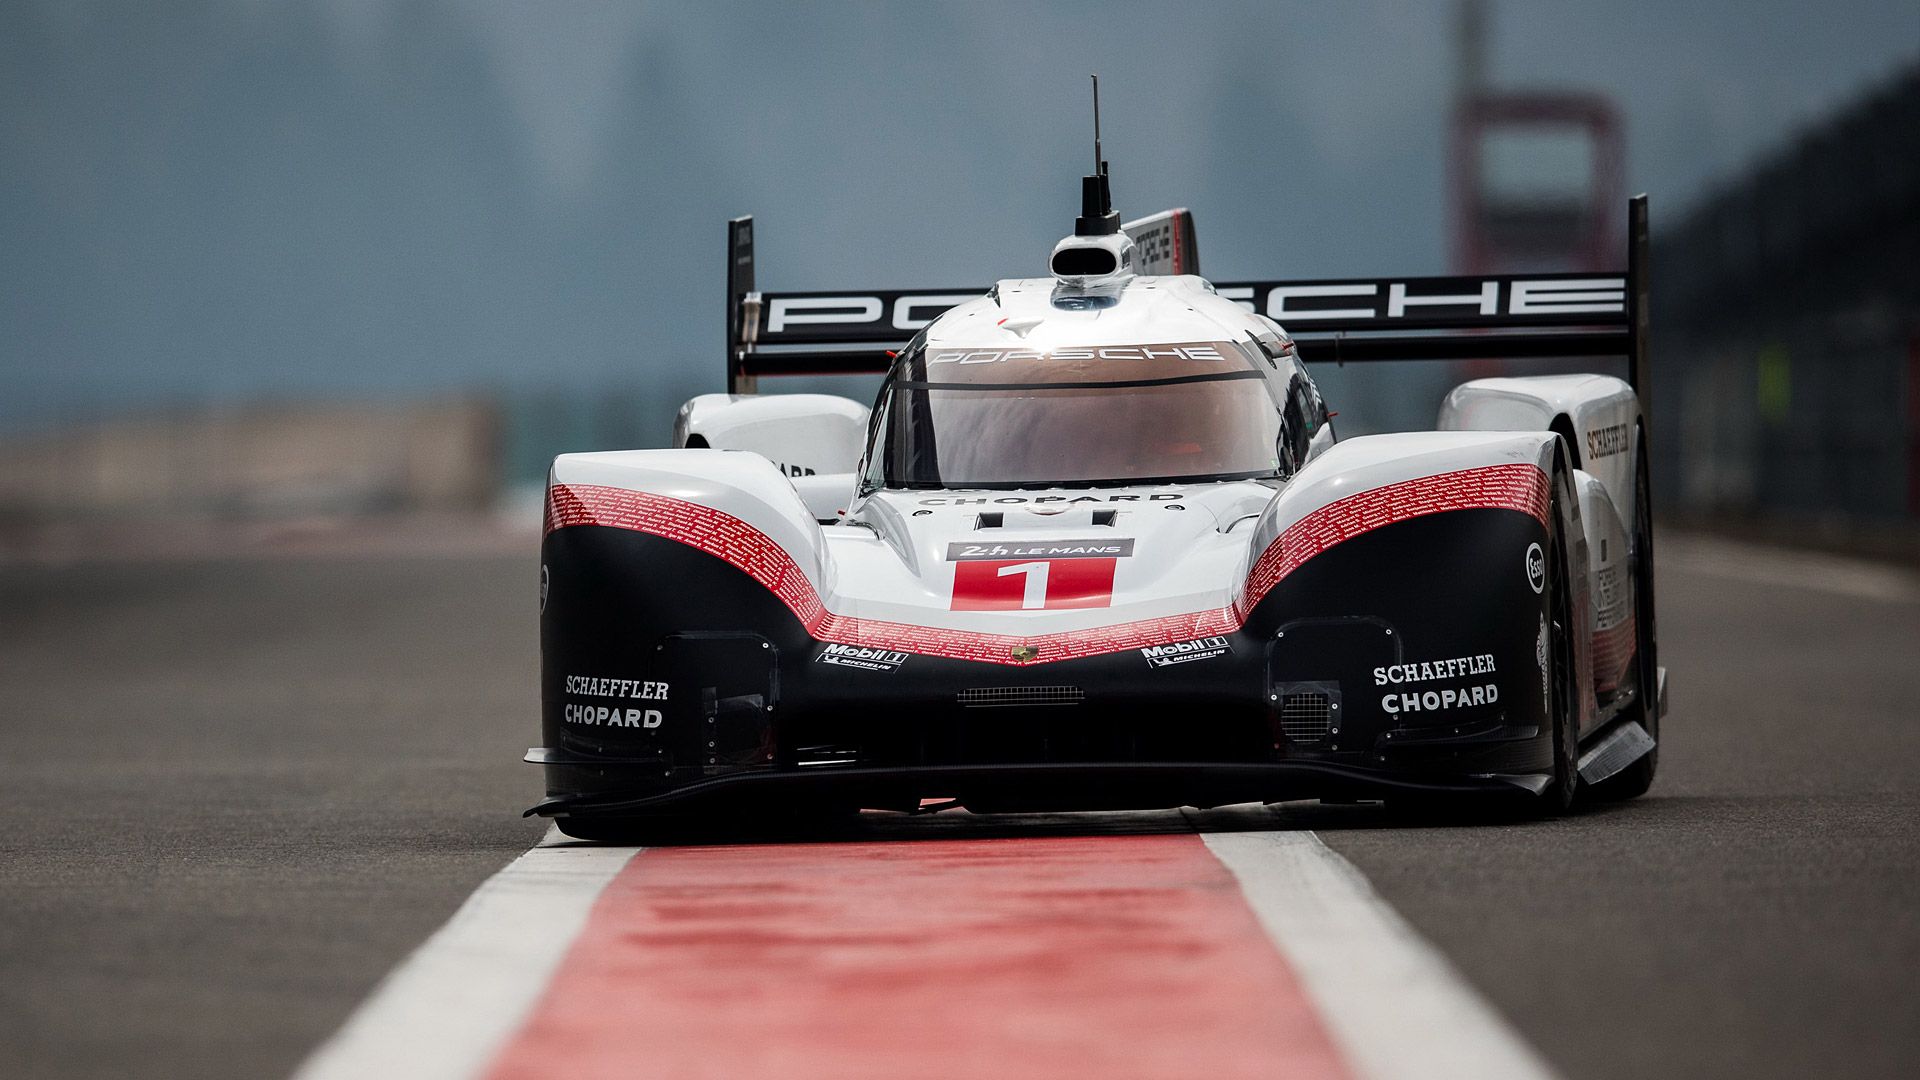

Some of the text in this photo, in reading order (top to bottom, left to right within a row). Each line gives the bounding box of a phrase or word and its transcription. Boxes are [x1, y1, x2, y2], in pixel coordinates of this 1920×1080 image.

[927, 346, 1225, 367] PORSCHE
[918, 494, 1185, 505] CHOPARD
[1050, 546, 1121, 554] MANS
[997, 561, 1050, 609] 1
[824, 644, 887, 661] Mobil
[1140, 639, 1205, 658] Mobil
[1173, 649, 1225, 662] MICHELIN
[840, 658, 892, 670] MICHELIN
[1373, 654, 1496, 685] SCHAEFFLER
[565, 675, 669, 700] SCHAEFFLER
[1381, 684, 1499, 714] CHOPARD
[565, 704, 663, 729] CHOPARD
